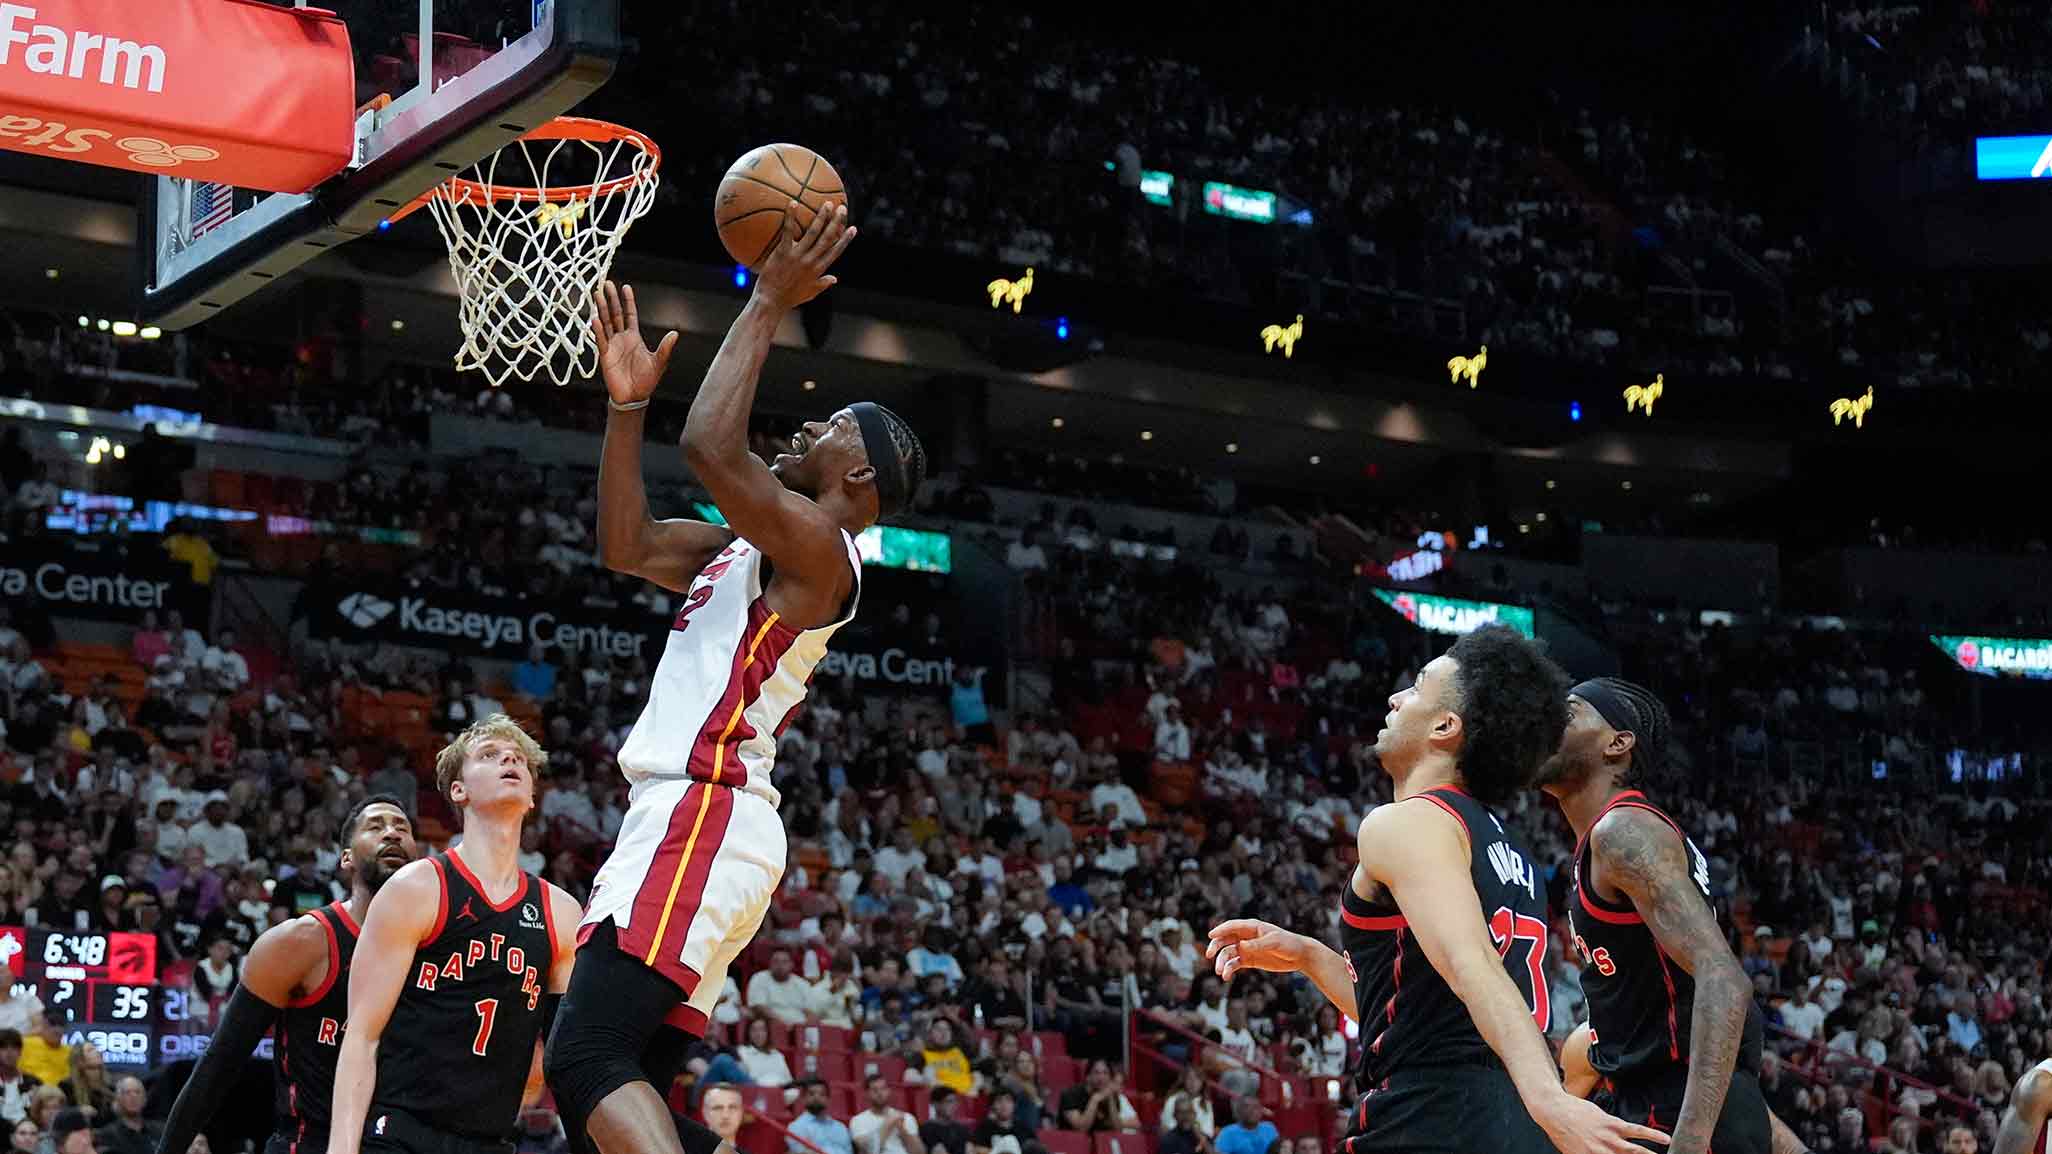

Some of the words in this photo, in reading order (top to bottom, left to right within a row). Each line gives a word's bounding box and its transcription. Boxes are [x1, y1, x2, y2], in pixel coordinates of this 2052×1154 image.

[0, 3, 166, 93] Farm
[0, 567, 27, 596] a
[35, 562, 170, 608] Center
[401, 597, 523, 647] Kaseya
[528, 613, 648, 657] Center
[816, 651, 877, 680] eya
[43, 933, 106, 966] 6:48
[416, 933, 541, 1011] RAPTORS
[111, 986, 149, 1019] 35
[472, 998, 498, 1057] 1
